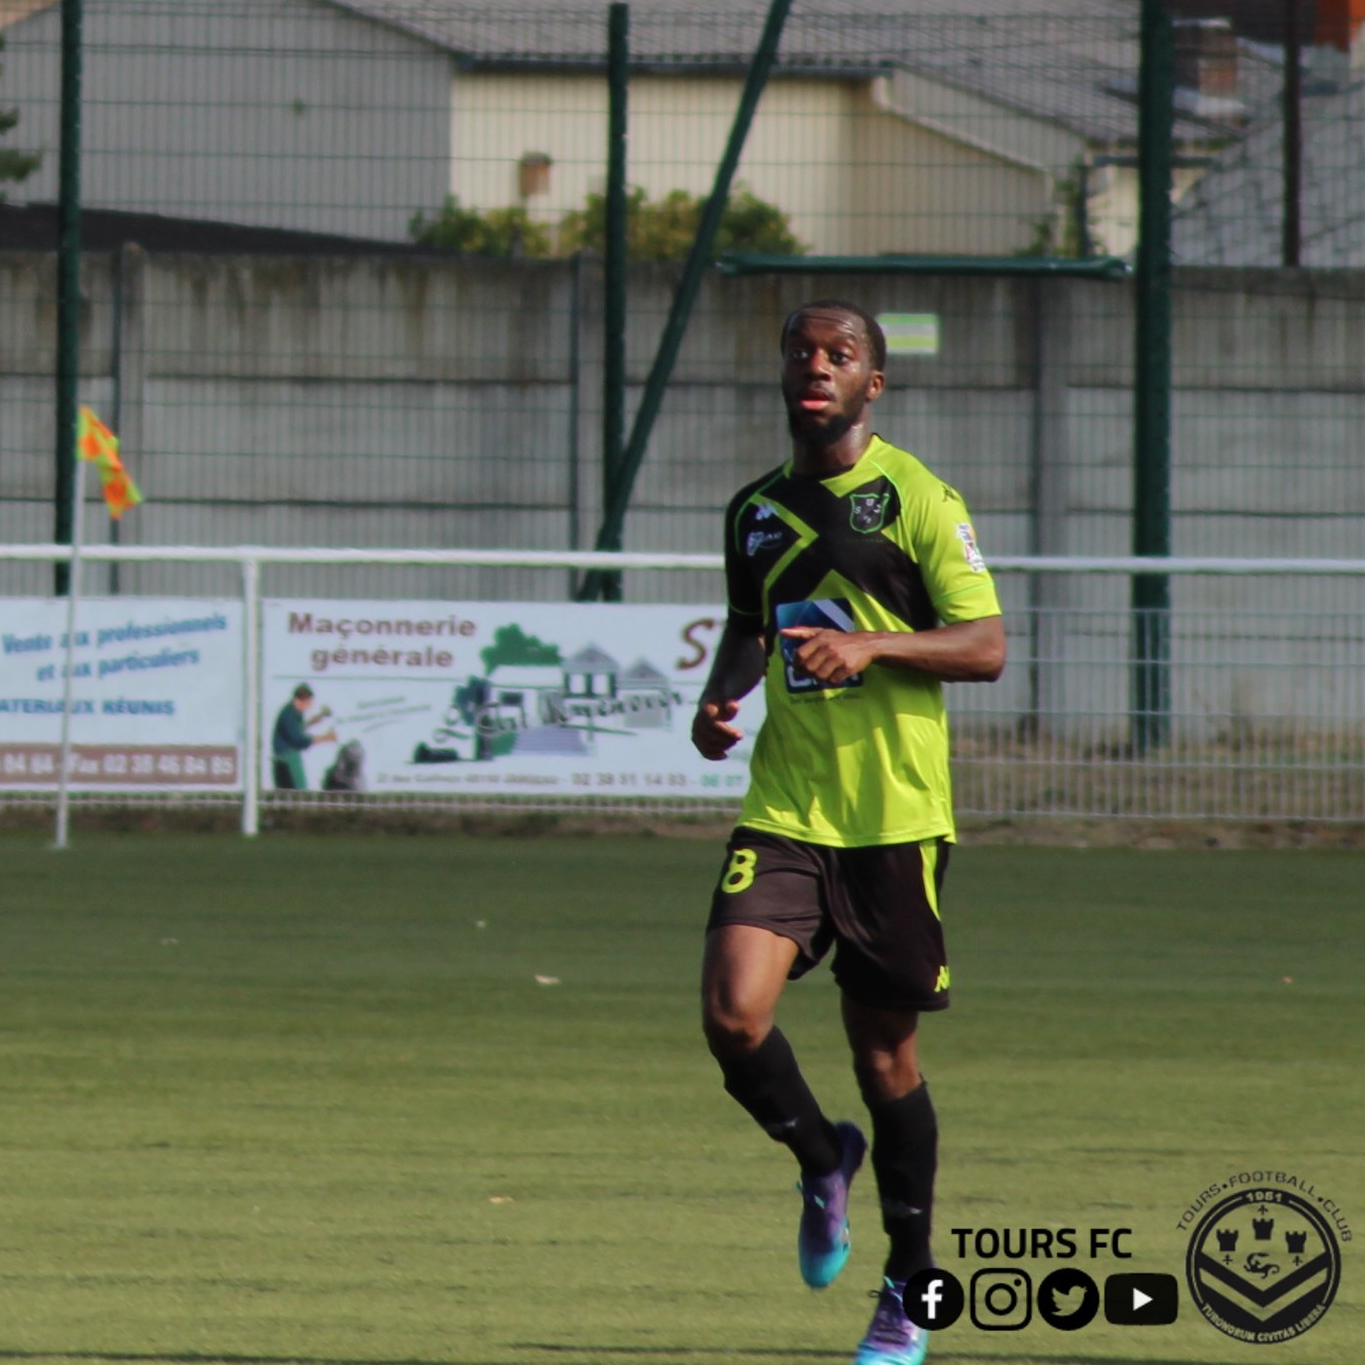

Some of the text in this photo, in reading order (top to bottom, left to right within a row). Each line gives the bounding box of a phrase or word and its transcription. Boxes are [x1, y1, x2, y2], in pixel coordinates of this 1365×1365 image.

[2, 633, 53, 655] Vente
[97, 611, 227, 649] professionnels
[288, 610, 476, 640] Maçonnerie
[98, 647, 200, 680] particuliers
[310, 645, 454, 672] générale
[721, 847, 758, 894] 8
